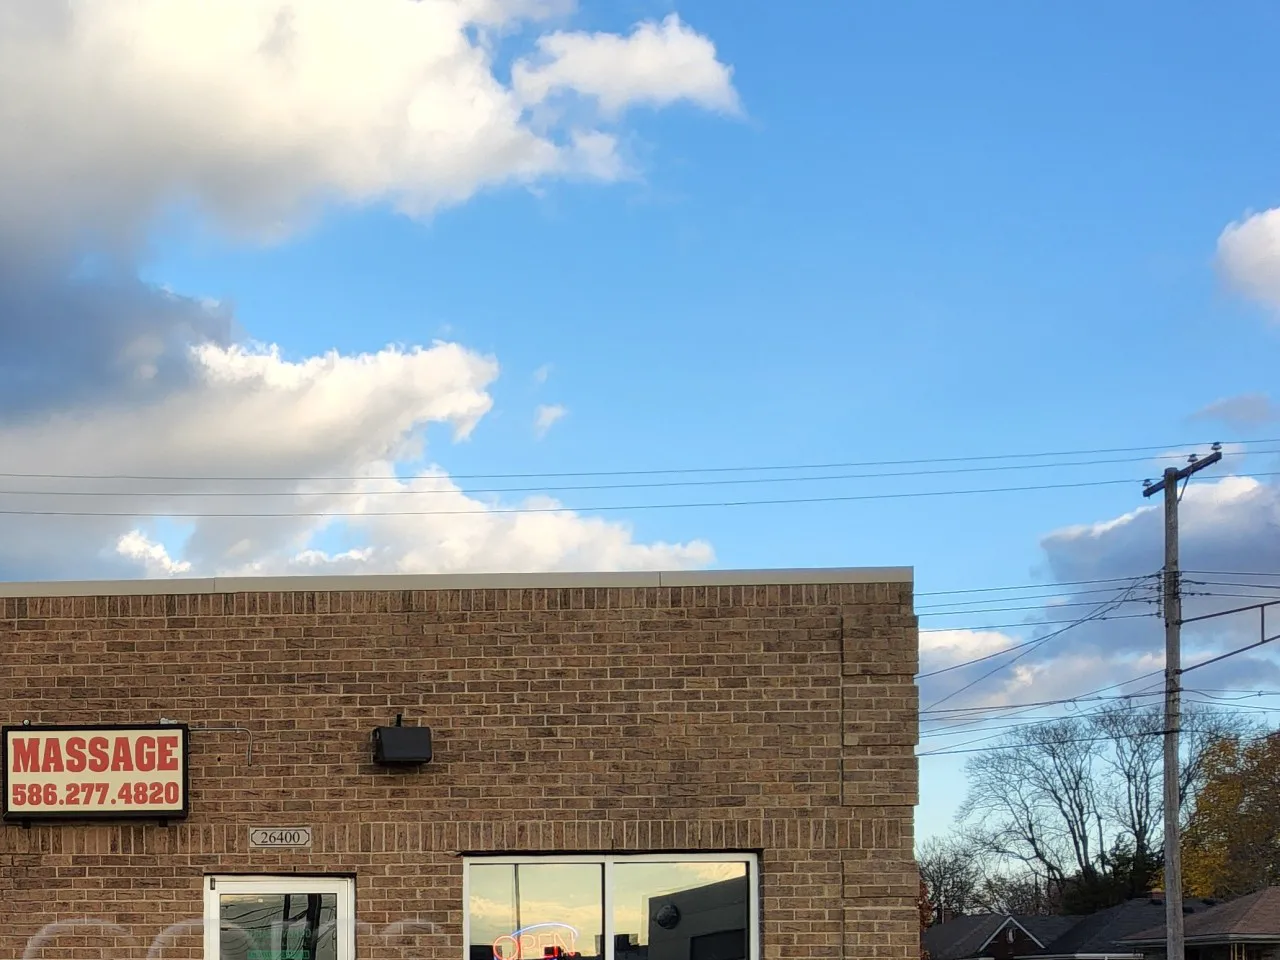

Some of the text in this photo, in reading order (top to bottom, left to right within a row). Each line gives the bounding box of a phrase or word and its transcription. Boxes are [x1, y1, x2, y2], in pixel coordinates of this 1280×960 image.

[12, 735, 179, 773] MASSAGE
[12, 781, 180, 806] 586.277.4820
[260, 831, 301, 844] 26400
[493, 932, 575, 960] OPEN
